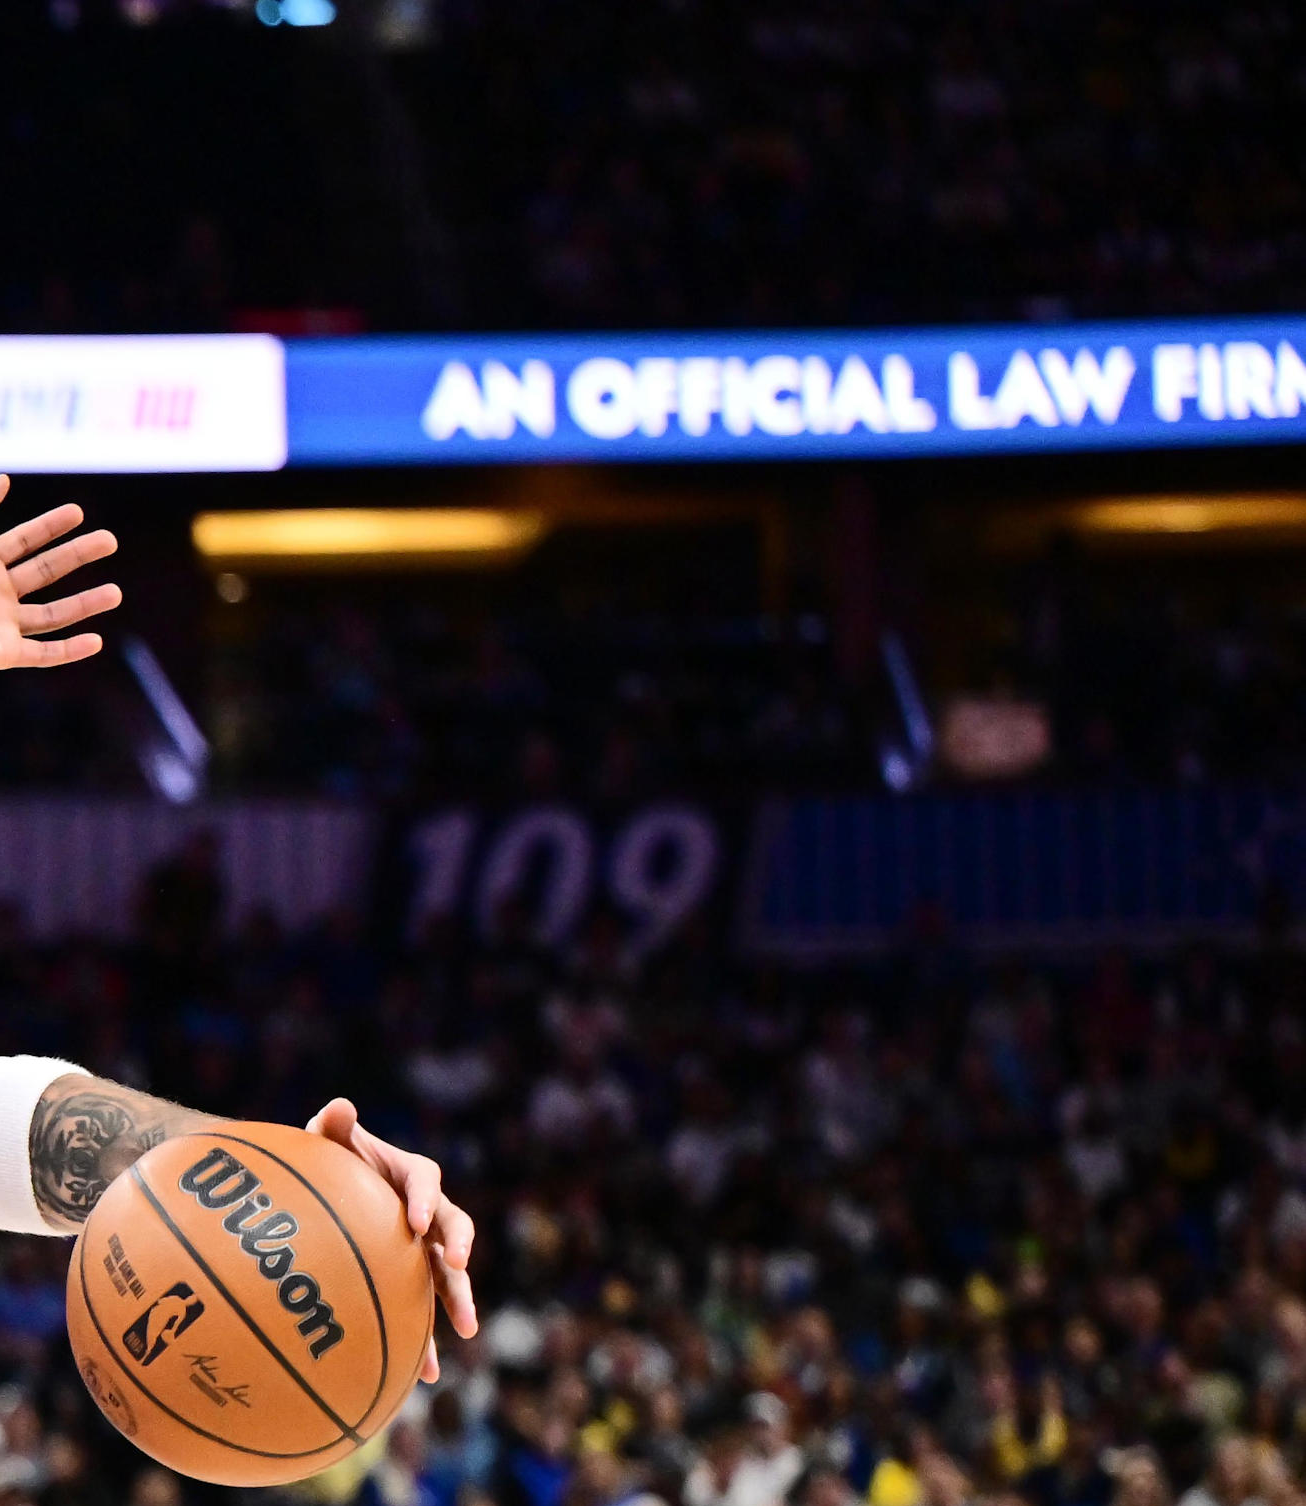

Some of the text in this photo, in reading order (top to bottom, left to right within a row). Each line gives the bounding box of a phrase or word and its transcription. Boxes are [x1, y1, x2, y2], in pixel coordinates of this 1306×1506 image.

[421, 359, 557, 441] AN
[566, 353, 937, 440] OFFICIAL
[947, 345, 1136, 431] LAW
[402, 804, 719, 968] 109
[178, 1147, 345, 1361] Wilson
